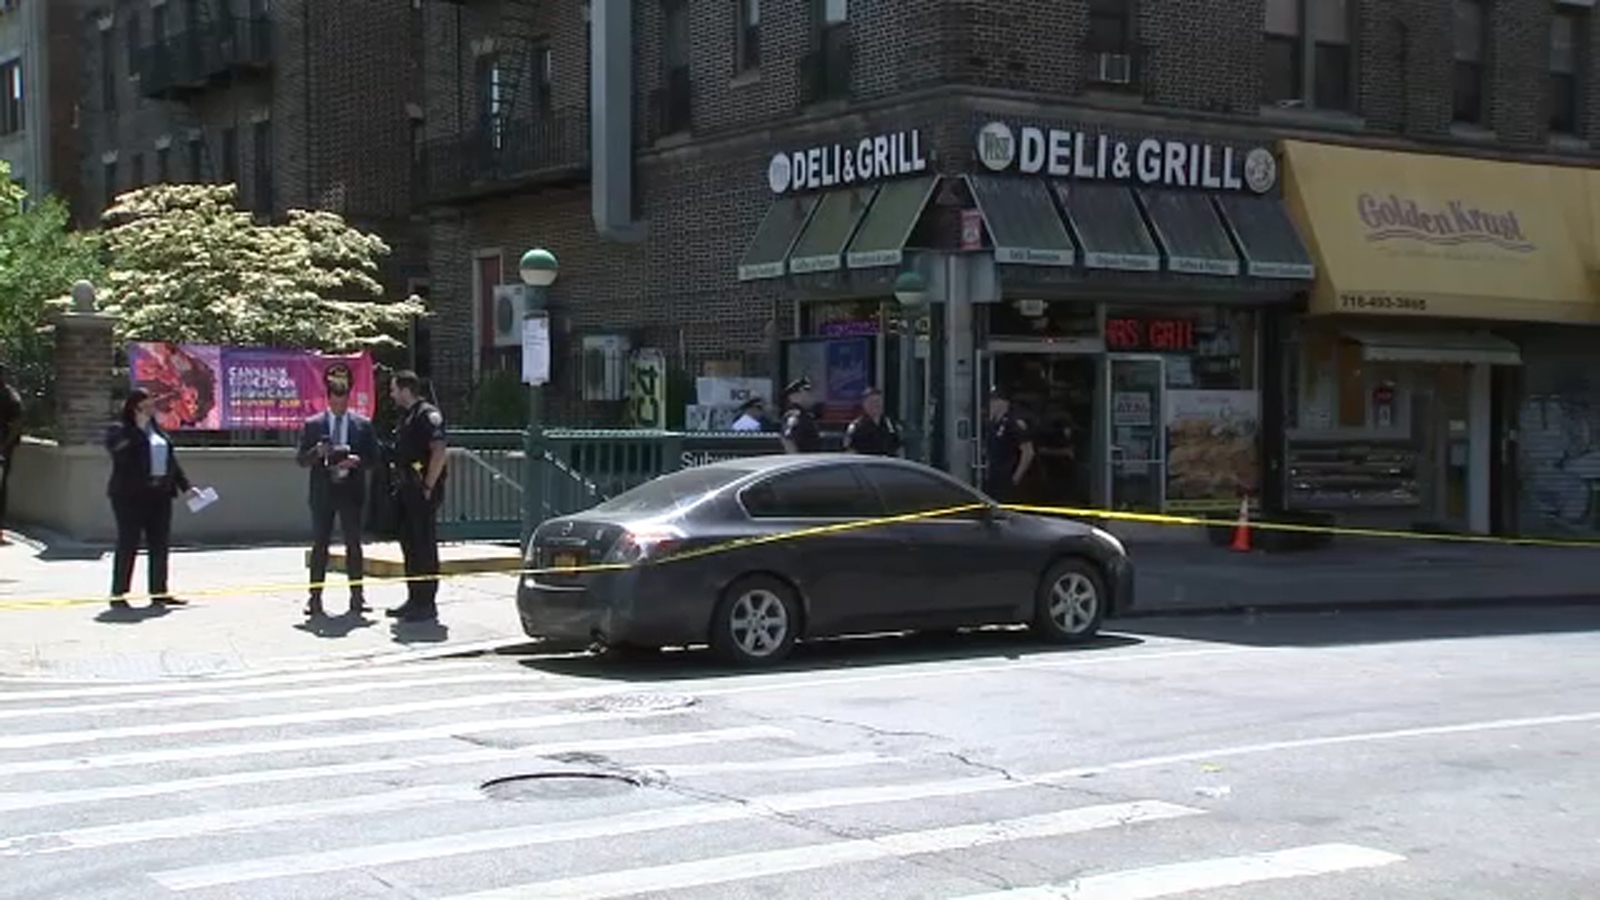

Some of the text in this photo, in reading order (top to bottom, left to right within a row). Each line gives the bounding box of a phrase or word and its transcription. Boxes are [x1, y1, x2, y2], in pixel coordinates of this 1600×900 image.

[792, 143, 841, 191] DELI
[856, 129, 925, 179] GRILL
[1018, 126, 1107, 179] DELI
[1136, 138, 1242, 190] GRILL
[1357, 193, 1450, 236] Golden
